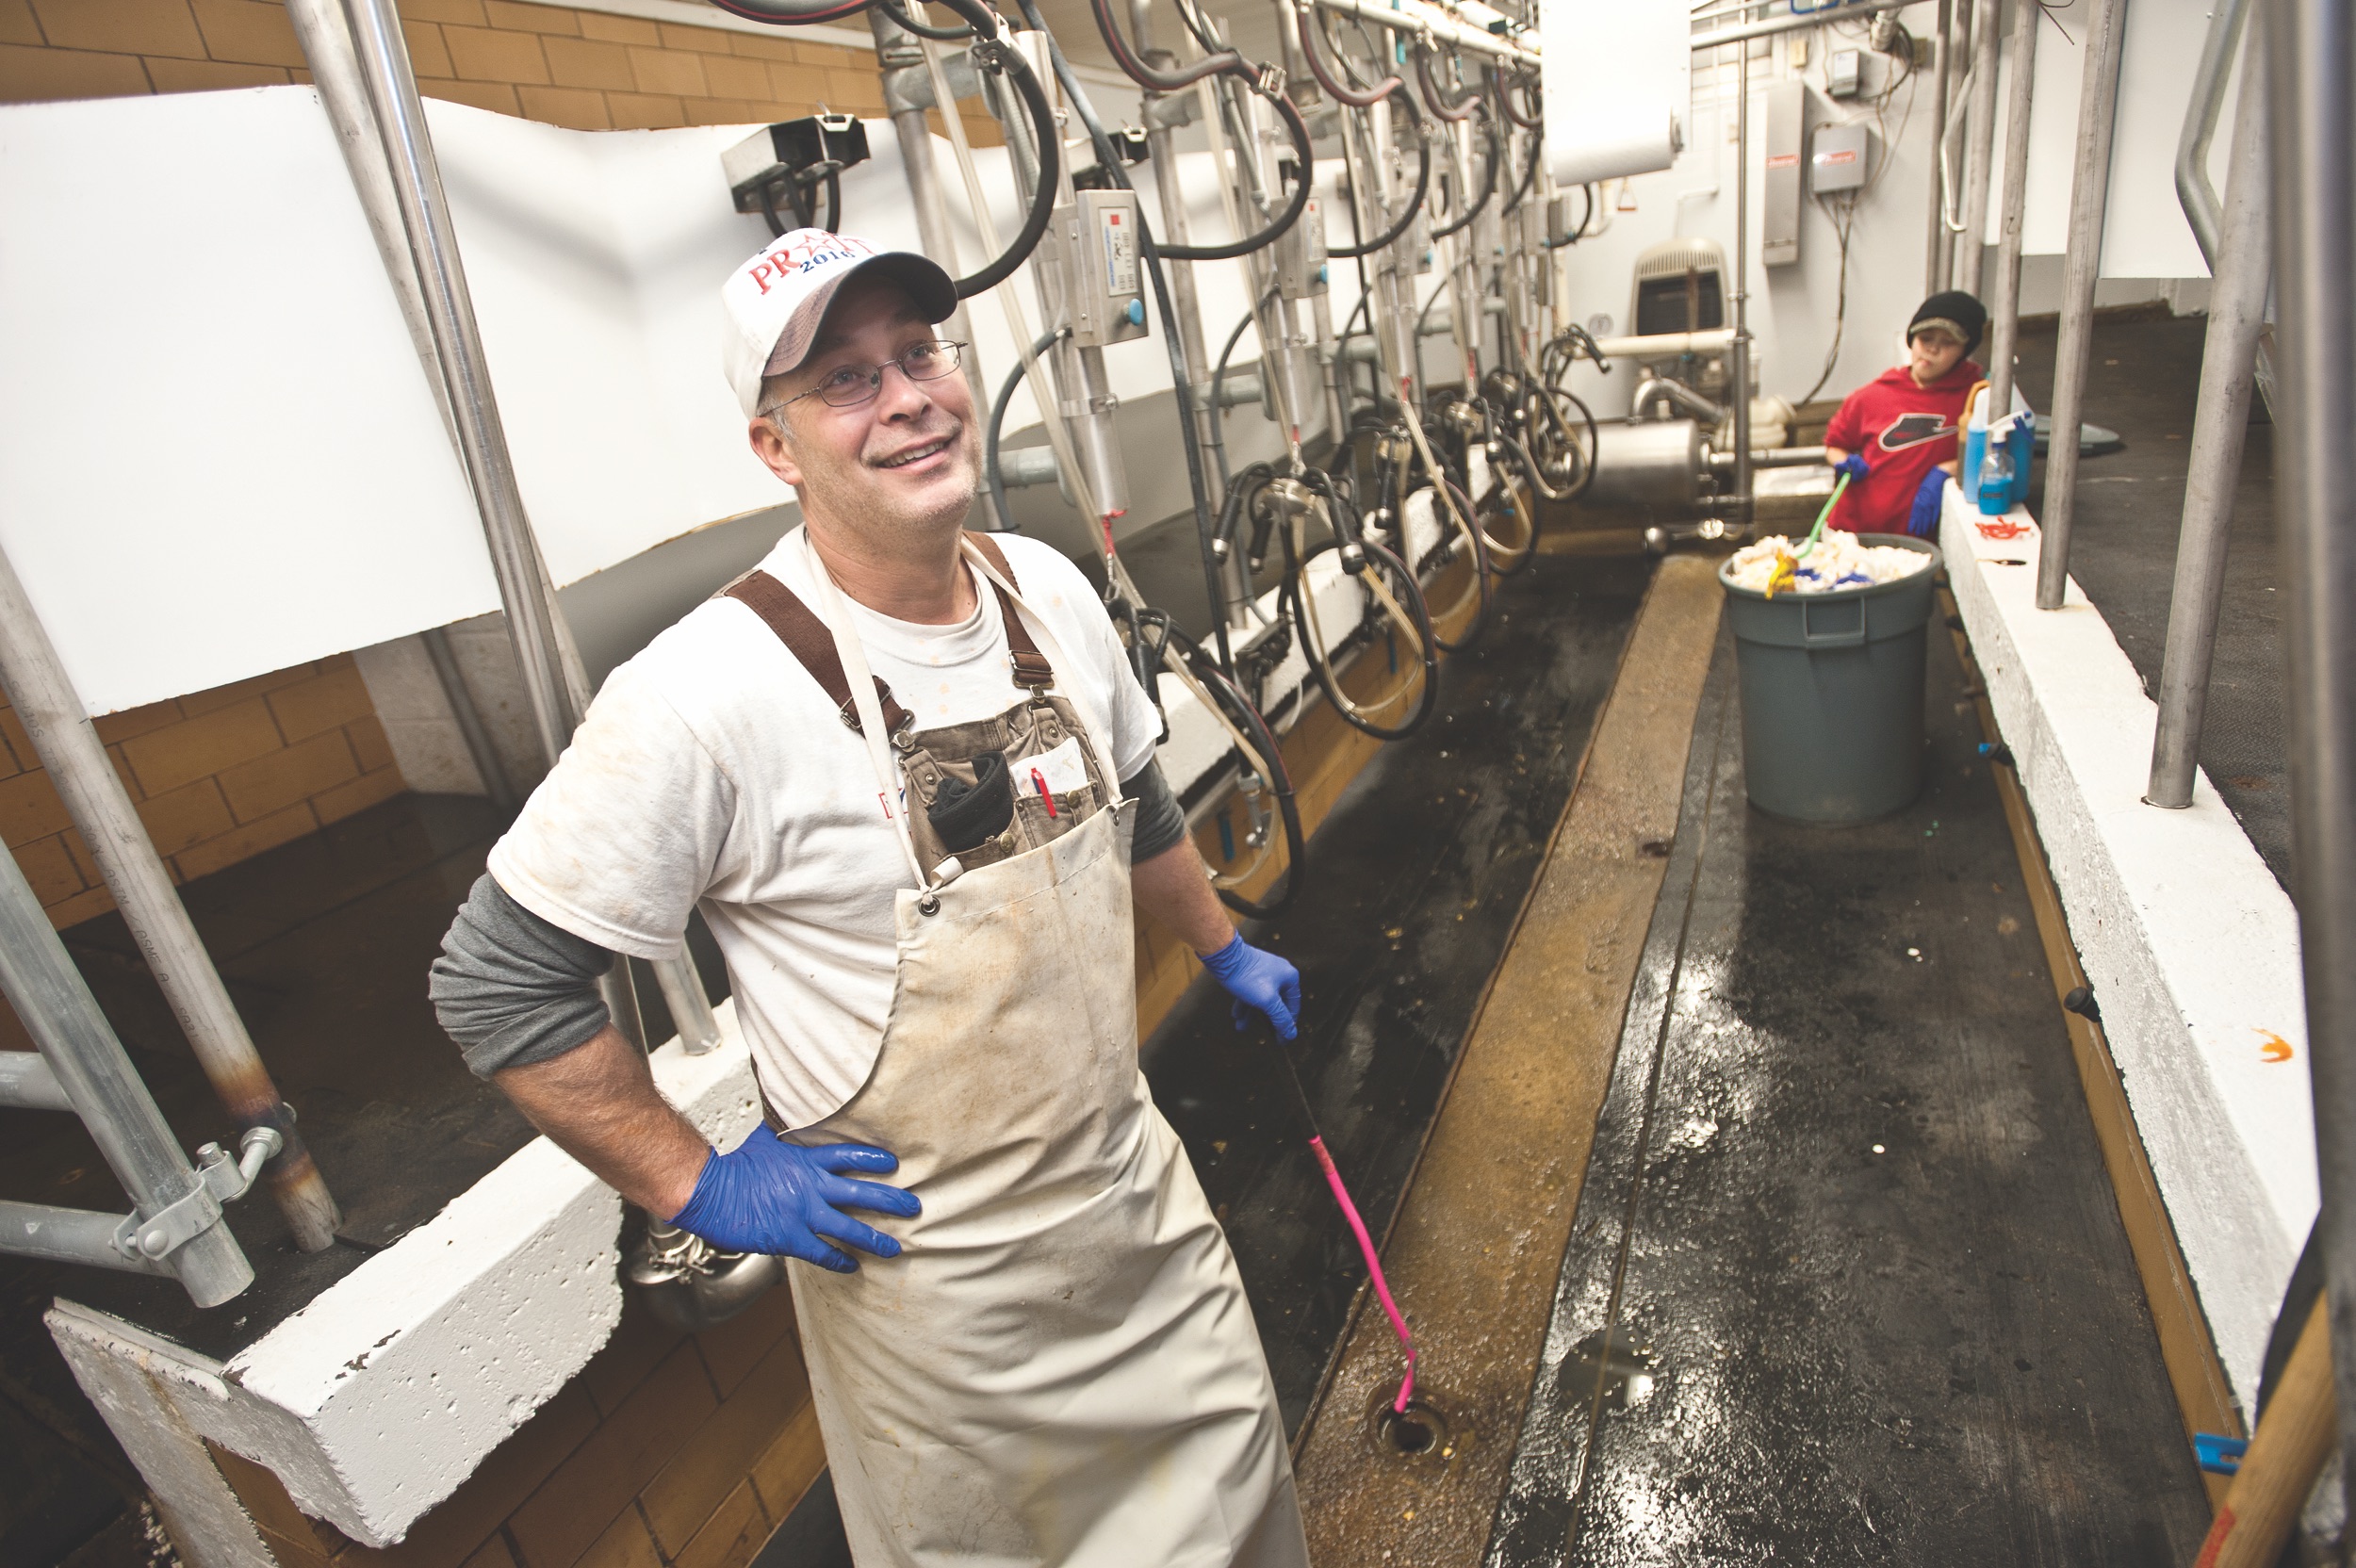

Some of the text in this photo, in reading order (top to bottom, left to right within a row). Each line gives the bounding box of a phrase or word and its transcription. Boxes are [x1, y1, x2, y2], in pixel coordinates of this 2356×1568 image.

[799, 252, 856, 273] 2016
[105, 869, 130, 905] ASTM
[136, 930, 161, 963] ASME
[157, 972, 170, 983] A
[176, 1007, 200, 1038] SA31
